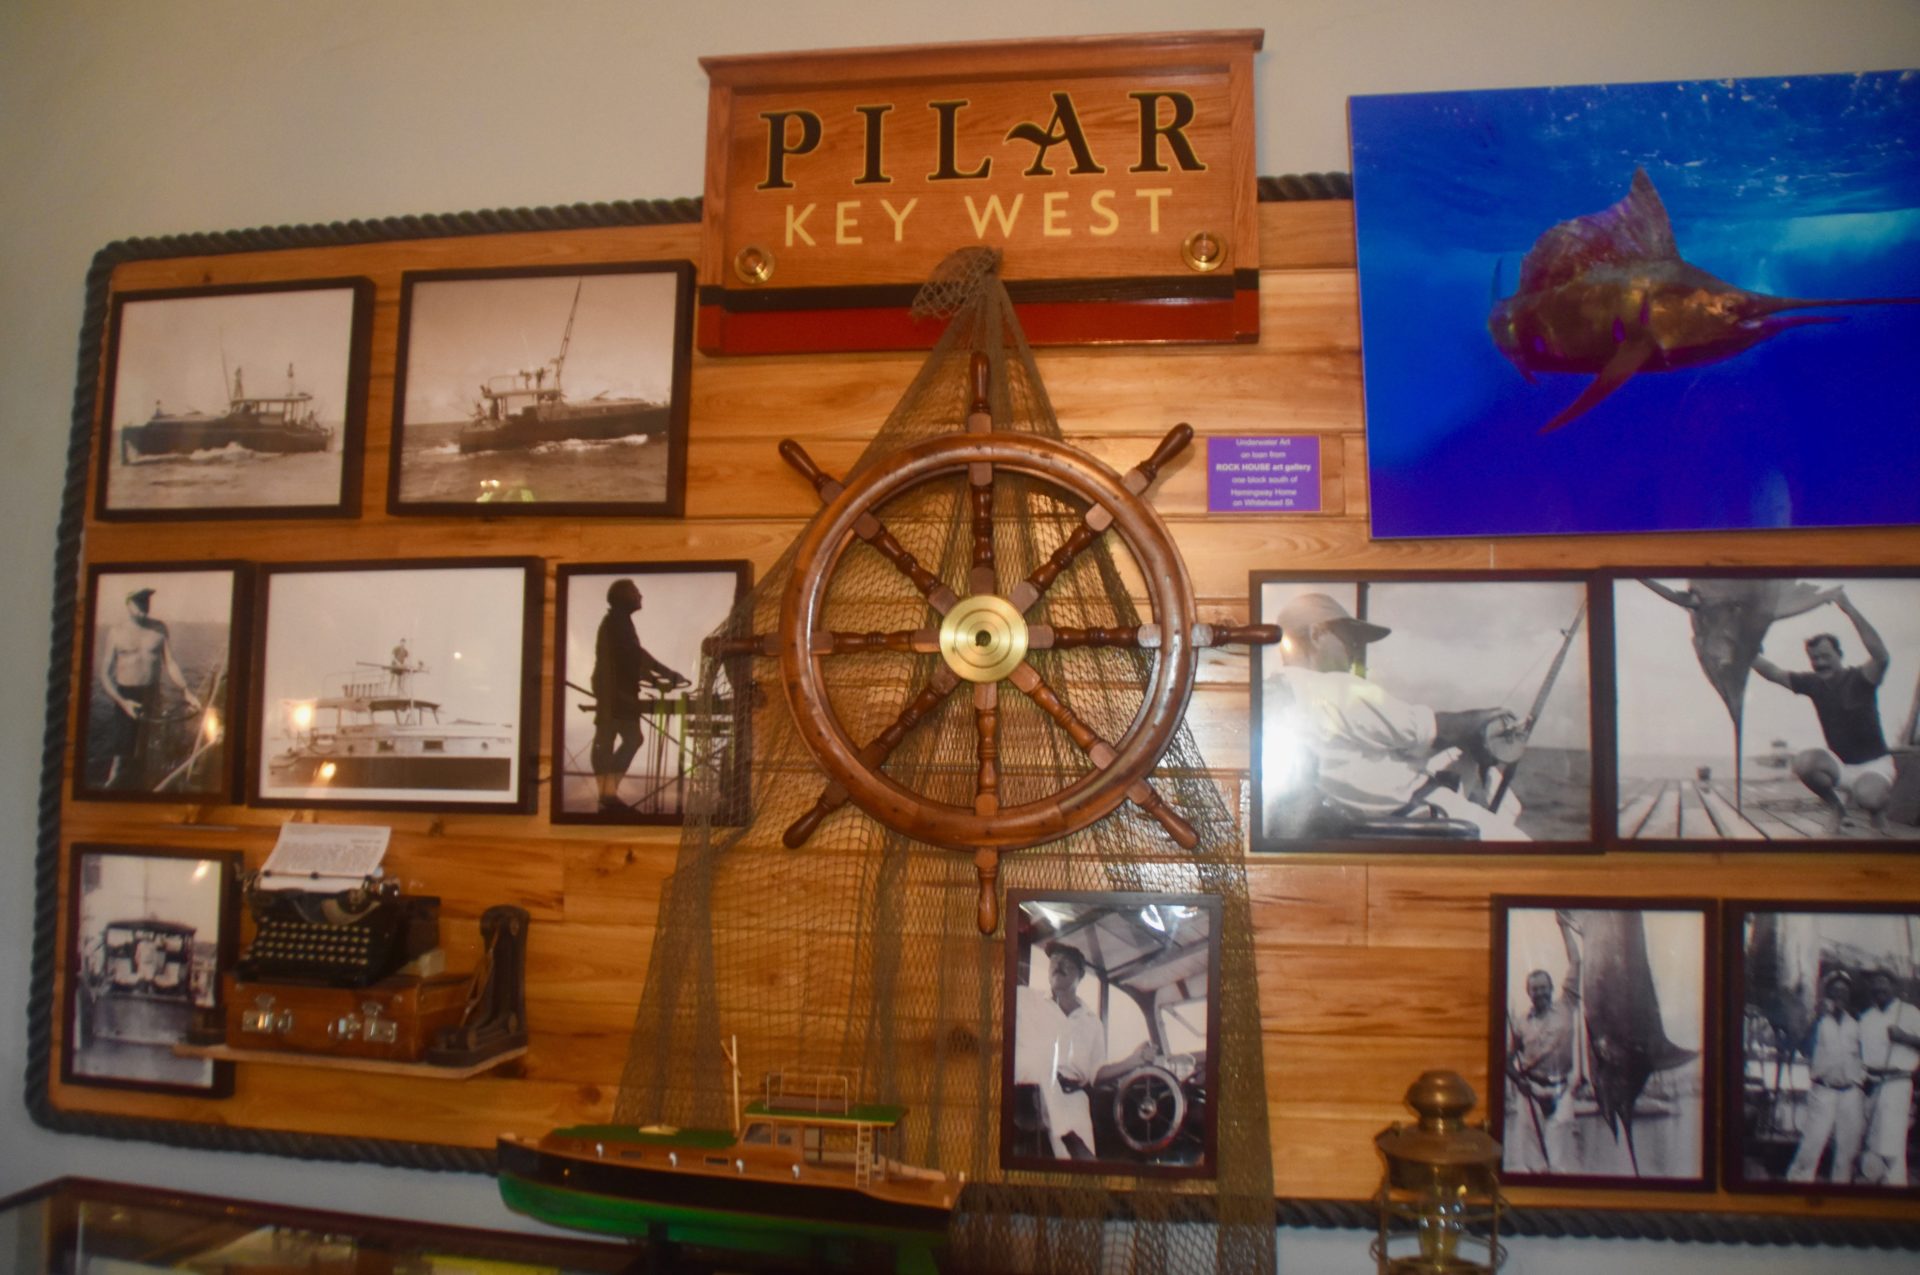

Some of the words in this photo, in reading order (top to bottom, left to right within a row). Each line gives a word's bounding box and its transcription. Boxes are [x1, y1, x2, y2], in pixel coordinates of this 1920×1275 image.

[755, 91, 1207, 191] PILAR
[784, 198, 918, 247] KEY
[964, 188, 1172, 240] WEST
[1235, 438, 1278, 446] Underwater
[1279, 438, 1291, 446] Art
[1251, 451, 1268, 459] loan
[1269, 451, 1286, 459] from
[1216, 463, 1240, 472] ROCK
[1242, 463, 1271, 471] HOUSE
[1285, 463, 1311, 473] gallery
[1247, 476, 1266, 484] block
[1268, 476, 1289, 484] south
[1290, 476, 1298, 484] of
[1230, 489, 1273, 498] Hemingway
[1244, 499, 1283, 507] Whitehead
